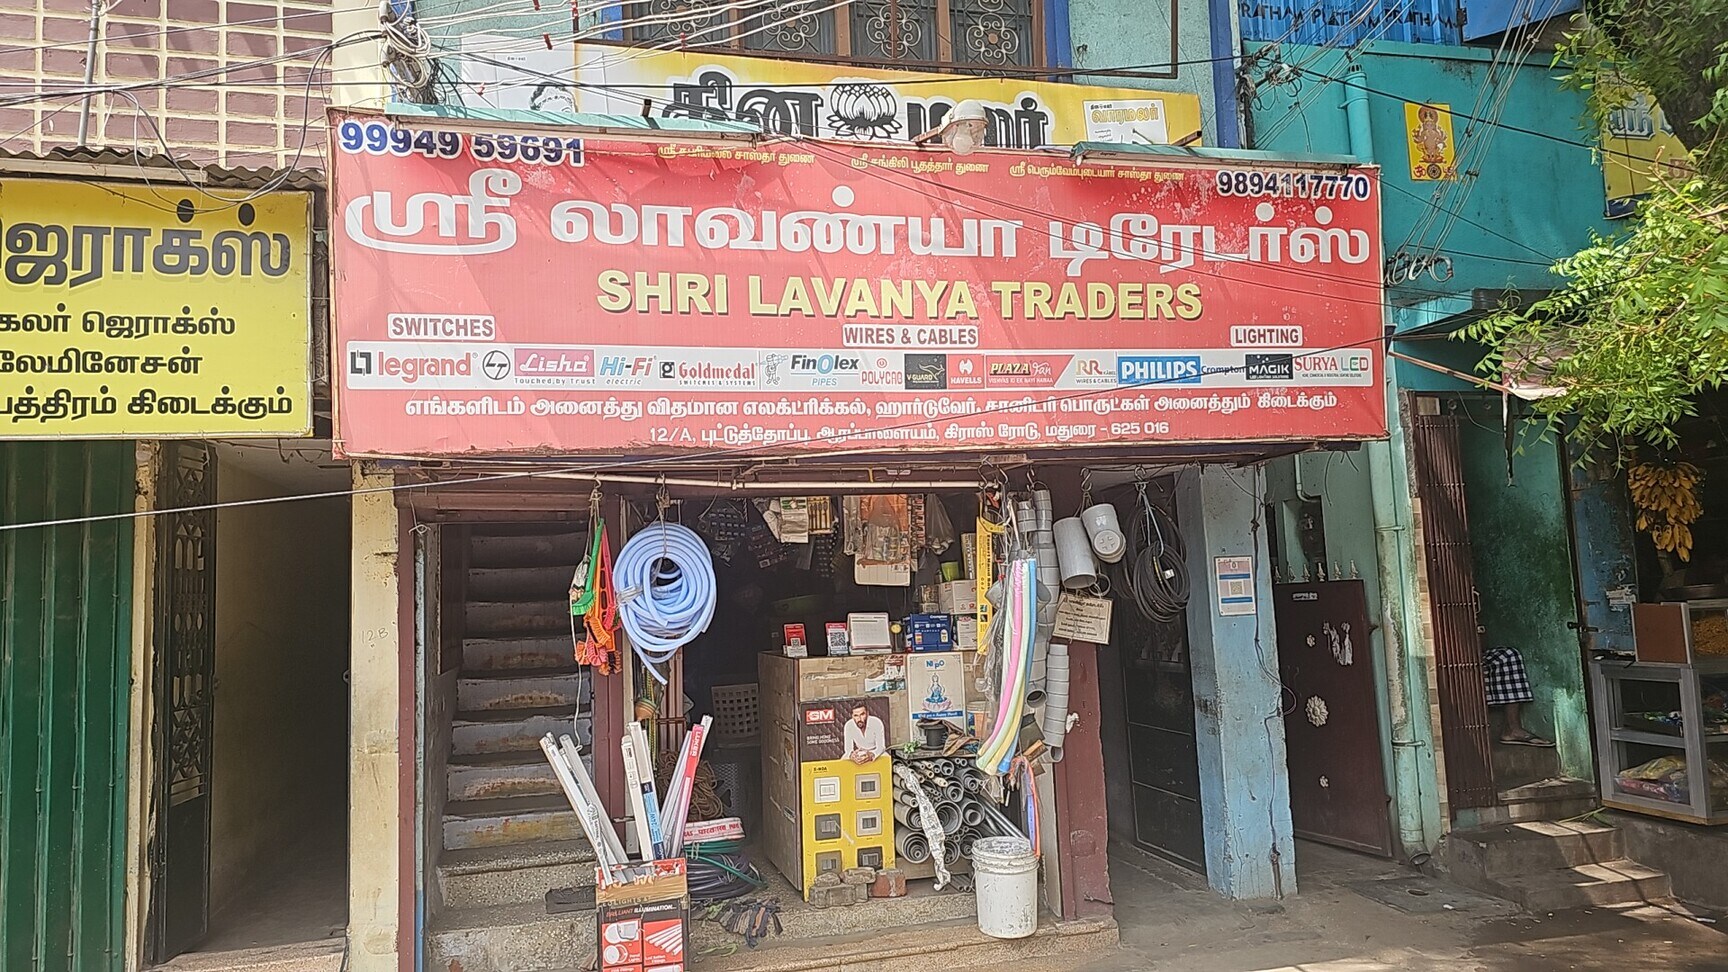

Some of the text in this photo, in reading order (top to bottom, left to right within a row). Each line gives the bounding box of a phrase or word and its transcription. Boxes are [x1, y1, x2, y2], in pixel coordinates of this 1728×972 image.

[1239, 3, 1303, 20] RATHAM
[339, 122, 583, 165] 99949 59691
[955, 162, 990, 175] துணை
[1217, 171, 1370, 199] 9894117770
[345, 168, 1370, 277] ஸ்ரீ லாவண்யா டிரேடர்ஸ்
[0, 199, 292, 288] ஜராக்ஸ்
[597, 270, 1204, 321] SHRI LAVANYA TRADERS
[0, 302, 236, 340] கலர் ஜெராக்ஸ்
[391, 317, 494, 338] SWITCHES
[844, 327, 978, 346] WIRES & CABLES
[1235, 328, 1300, 345] LIGHTING
[0, 346, 203, 375] லேமினேசன்
[378, 351, 472, 384] legrand
[519, 353, 590, 373] Lisha
[600, 355, 653, 376] Hi-Fi
[989, 362, 1030, 375] PLAZA
[1075, 360, 1102, 376] RR
[1200, 364, 1245, 376] Crompton
[1248, 364, 1290, 375] MAGIK
[1294, 356, 1369, 372] SURYA LED
[678, 361, 756, 380] Goldmedal
[861, 370, 903, 385] POLYCAB
[1121, 361, 1198, 380] PHILIPS
[605, 378, 642, 386] electric
[811, 377, 837, 386] PIPES
[950, 376, 982, 385] HAVELLS
[127, 385, 293, 420] கிடைக்கும்
[405, 396, 526, 416] எங்களிடம்
[530, 396, 643, 421] அனைத்து
[647, 396, 738, 421] விதமான
[743, 396, 872, 417] எலக்ட்ரிக்கல்,
[1060, 393, 1150, 416] பொருட்கள்
[1154, 393, 1252, 414] அனைத்தும்
[1256, 392, 1338, 411] கிடைக்கும்
[650, 427, 697, 445] 12/A,
[944, 421, 994, 441] கிராஸ்
[998, 423, 1041, 441] ரோடு,
[1045, 423, 1097, 442] மதுரை
[1111, 423, 1141, 435] 625
[1143, 422, 1169, 434] 016
[809, 710, 834, 720] GM
